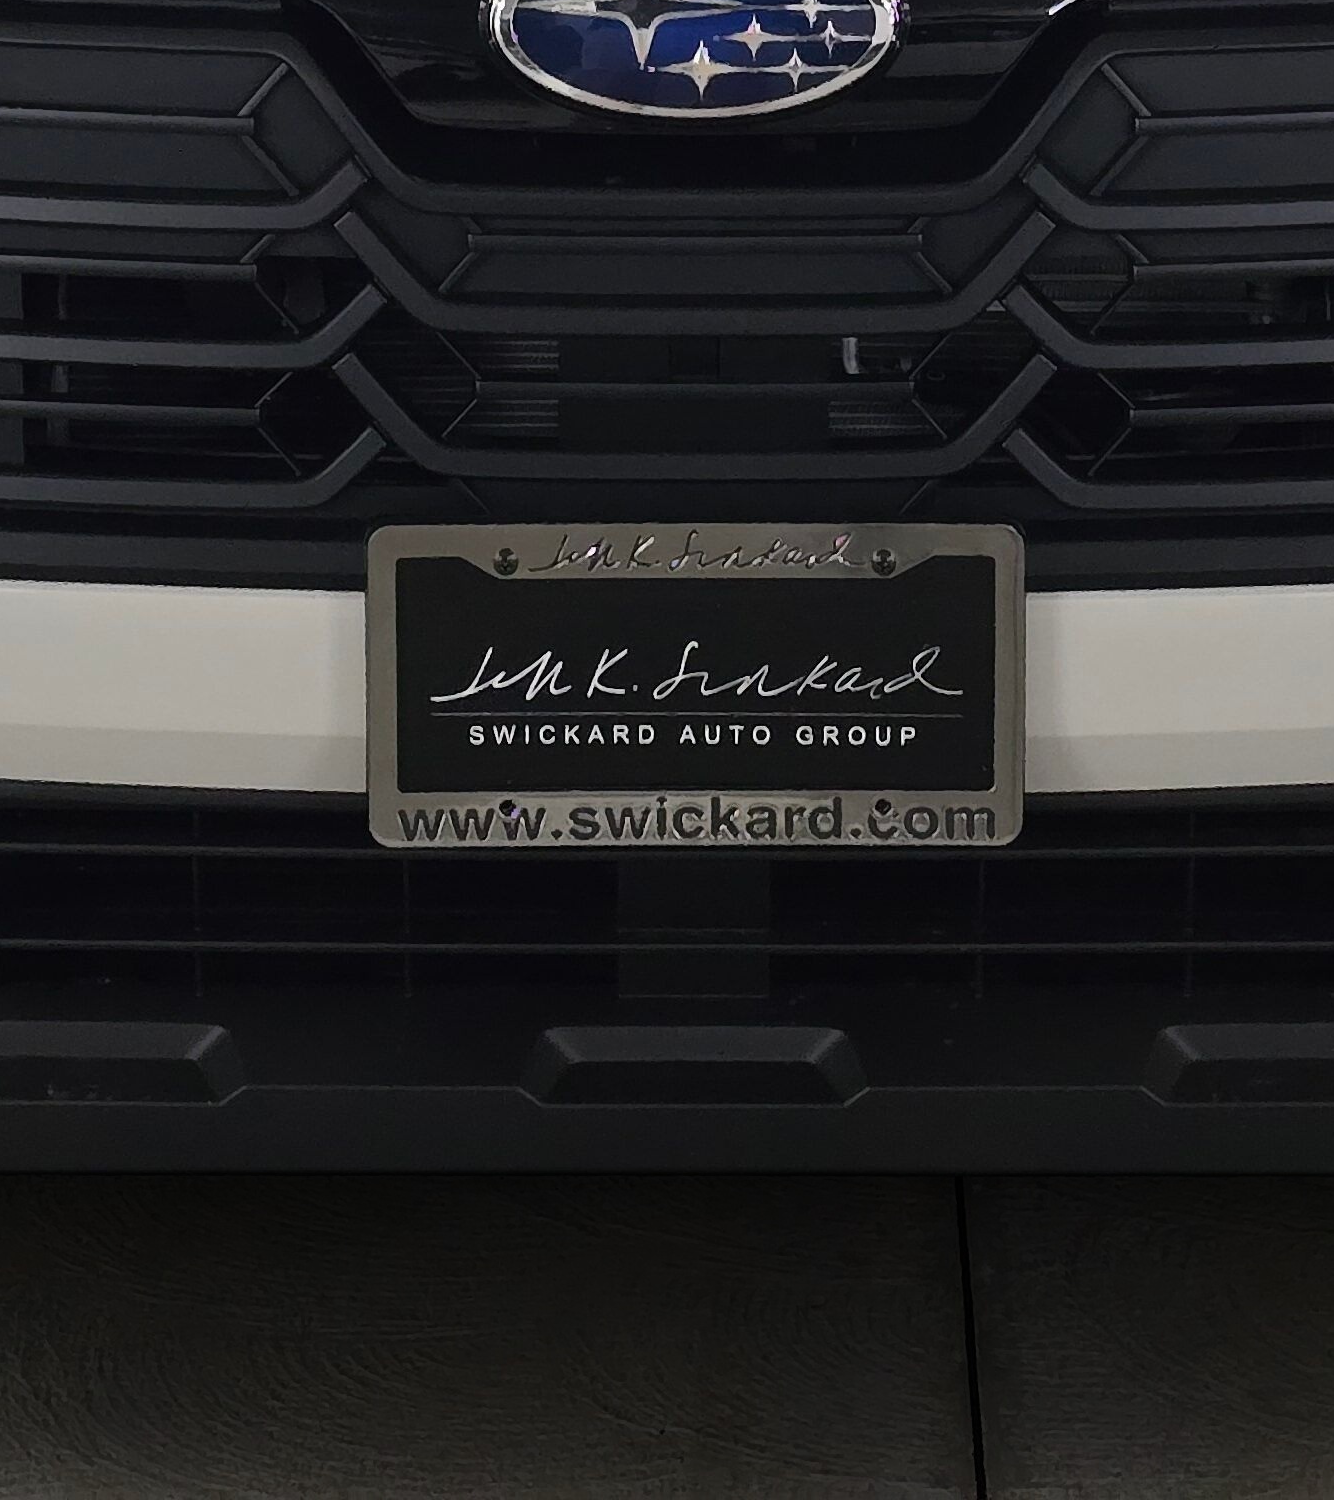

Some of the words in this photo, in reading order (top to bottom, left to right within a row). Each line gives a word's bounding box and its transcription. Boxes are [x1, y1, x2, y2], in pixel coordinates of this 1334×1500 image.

[586, 648, 638, 699] K.
[468, 723, 656, 747] SWICKARD
[678, 723, 772, 747] AUTO
[794, 724, 917, 748] GROUP
[397, 797, 998, 842] www.swickard.com
